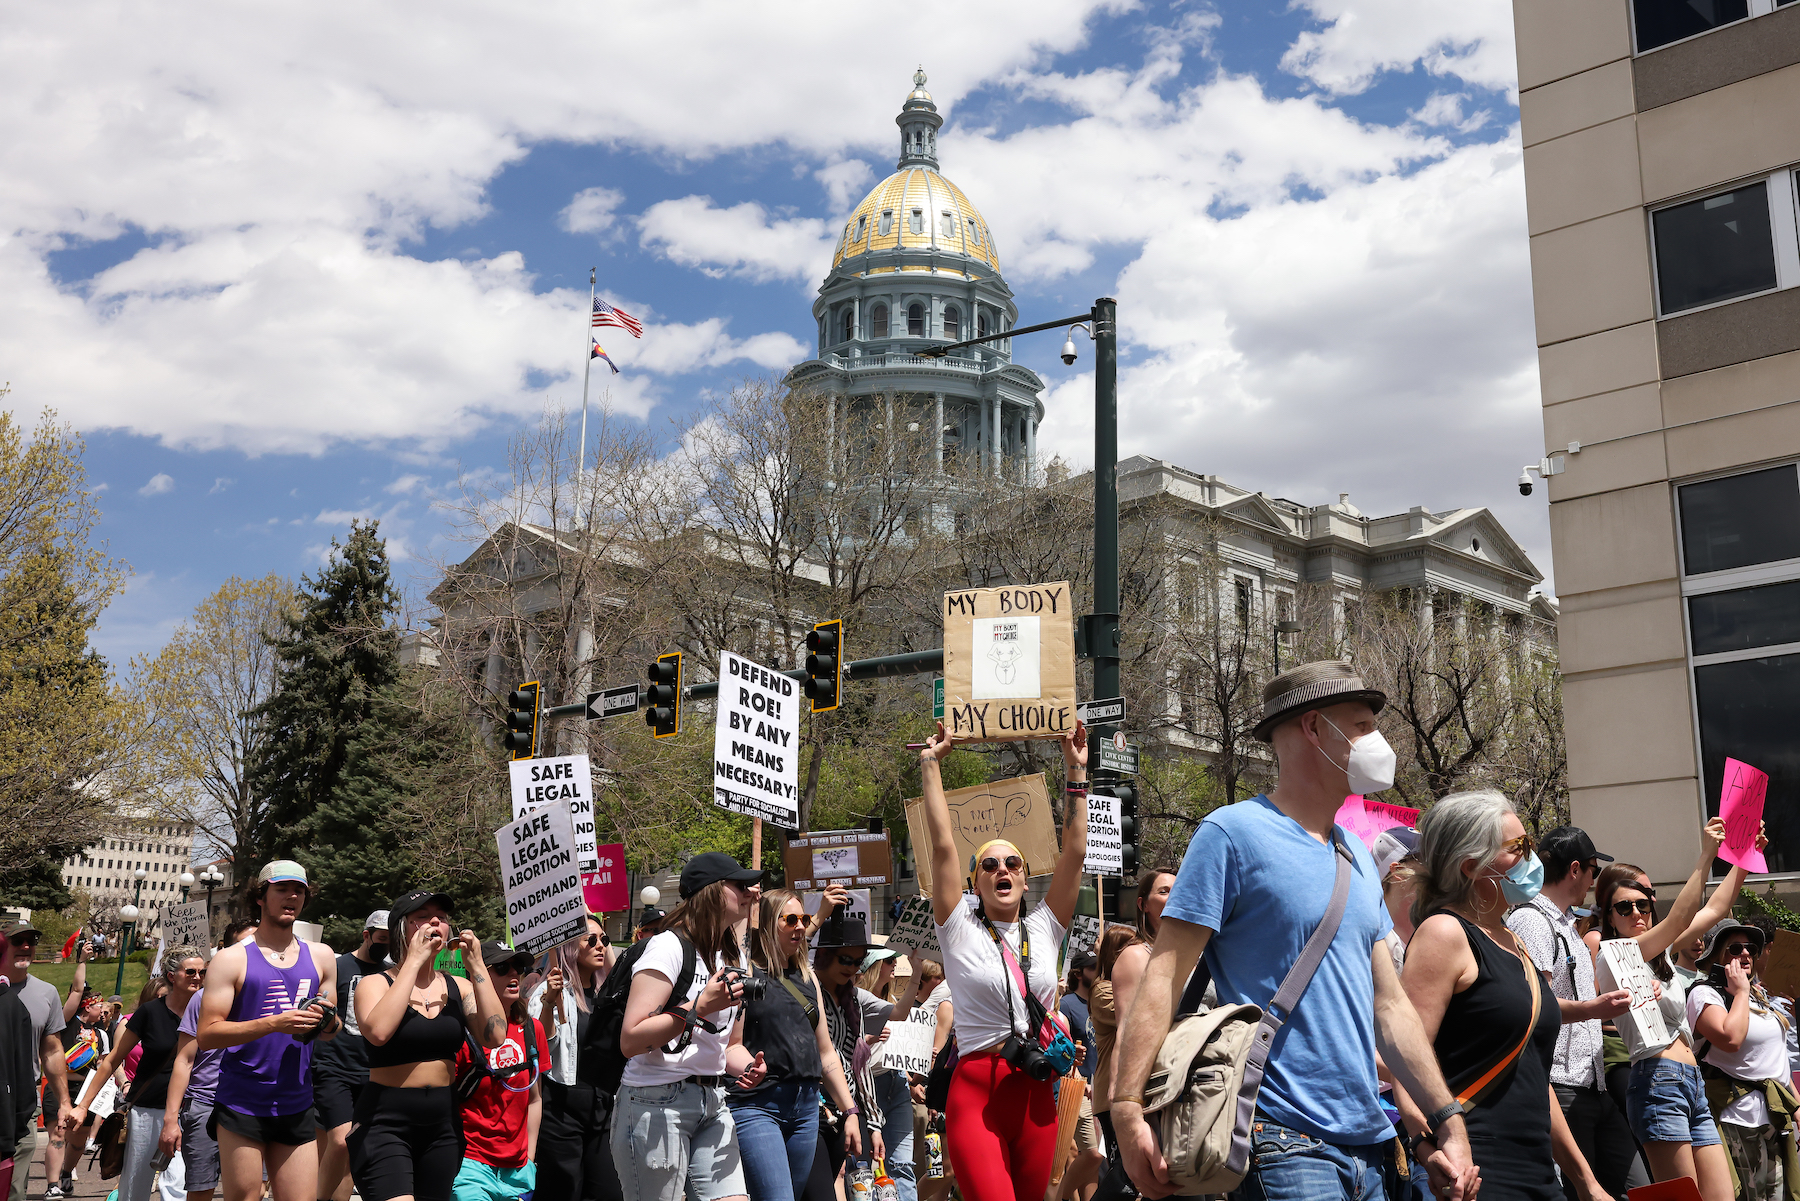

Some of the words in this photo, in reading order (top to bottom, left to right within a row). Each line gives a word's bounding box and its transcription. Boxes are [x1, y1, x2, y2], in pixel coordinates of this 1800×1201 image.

[948, 592, 977, 616] MY
[1000, 587, 1062, 614] BODY
[994, 633, 1003, 641] MY
[1002, 631, 1018, 641] CHOICE
[729, 657, 792, 697] DEFEND
[603, 697, 617, 710] ONE
[620, 693, 635, 706] WAY
[739, 686, 782, 720] ROE!
[952, 703, 989, 738] MY
[999, 704, 1071, 731] CHOICE
[1086, 708, 1102, 718] ONE
[1104, 705, 1121, 716] WAY
[729, 710, 752, 734] BY
[755, 721, 791, 748] ANY
[731, 740, 784, 773] MEANS
[1117, 754, 1135, 764] CENTER
[531, 763, 573, 782] SAFE
[716, 760, 797, 801] NECESSARY!
[526, 783, 581, 803] LEGAL
[729, 792, 748, 806] PARTY
[749, 798, 760, 810] FOR
[760, 802, 789, 818] SOCIALISM
[729, 802, 741, 814] AND
[741, 805, 773, 823] LIBERATION
[969, 808, 994, 821] NOT
[1088, 800, 1111, 812] SAFE
[513, 813, 550, 846] SAFE
[1087, 825, 1119, 835] BORTION
[789, 840, 808, 848] STAY
[812, 837, 829, 845] OUT
[830, 835, 842, 844] OF
[844, 835, 858, 843] MY
[858, 833, 886, 841] UTERUS
[1091, 840, 1121, 849] DEMAND
[511, 834, 560, 870] LEGAL
[508, 849, 571, 890] ABORTION
[796, 881, 810, 889] ART
[816, 880, 827, 888] BY
[509, 897, 527, 916] ON
[528, 875, 577, 908] DEMAND
[167, 906, 196, 919] Keep
[511, 922, 526, 938] NO
[527, 895, 583, 931] APOLOGIES!
[164, 919, 179, 928] the
[896, 925, 924, 938] against
[526, 936, 543, 949] PARTY
[542, 931, 552, 941] FOR
[551, 919, 578, 937] SOCIALISM
[539, 933, 566, 951] LIBERATION
[889, 932, 921, 951] Coney
[439, 960, 453, 969] HER
